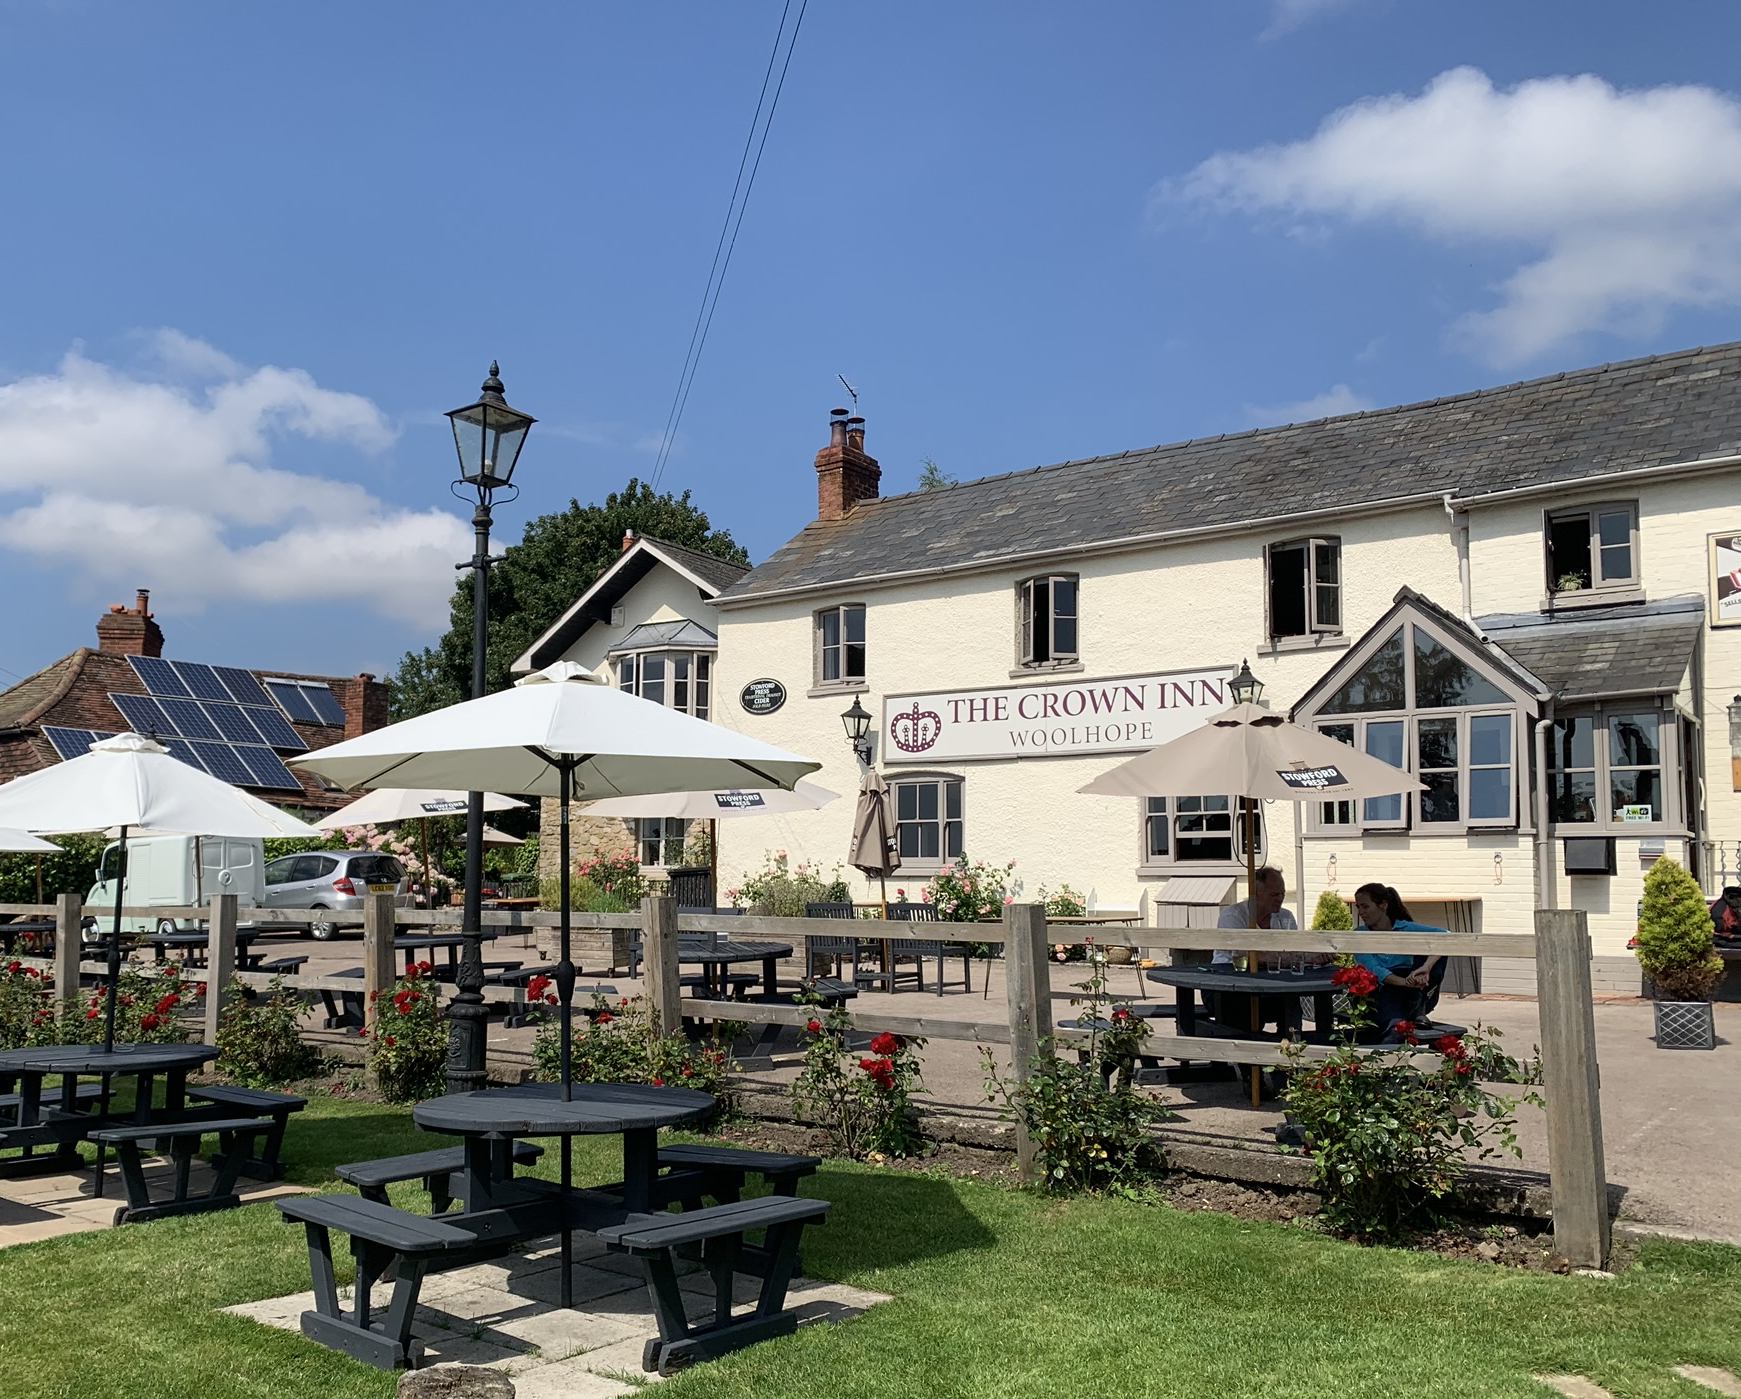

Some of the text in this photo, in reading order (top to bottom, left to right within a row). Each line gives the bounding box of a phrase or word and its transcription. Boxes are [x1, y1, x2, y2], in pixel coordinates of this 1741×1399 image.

[947, 677, 1226, 724] THE CROWN INN
[1008, 721, 1153, 748] WOOLHOPE
[1281, 768, 1338, 781] STOWFORD
[1301, 778, 1329, 787] PRESS
[717, 794, 760, 802] STOWFORD
